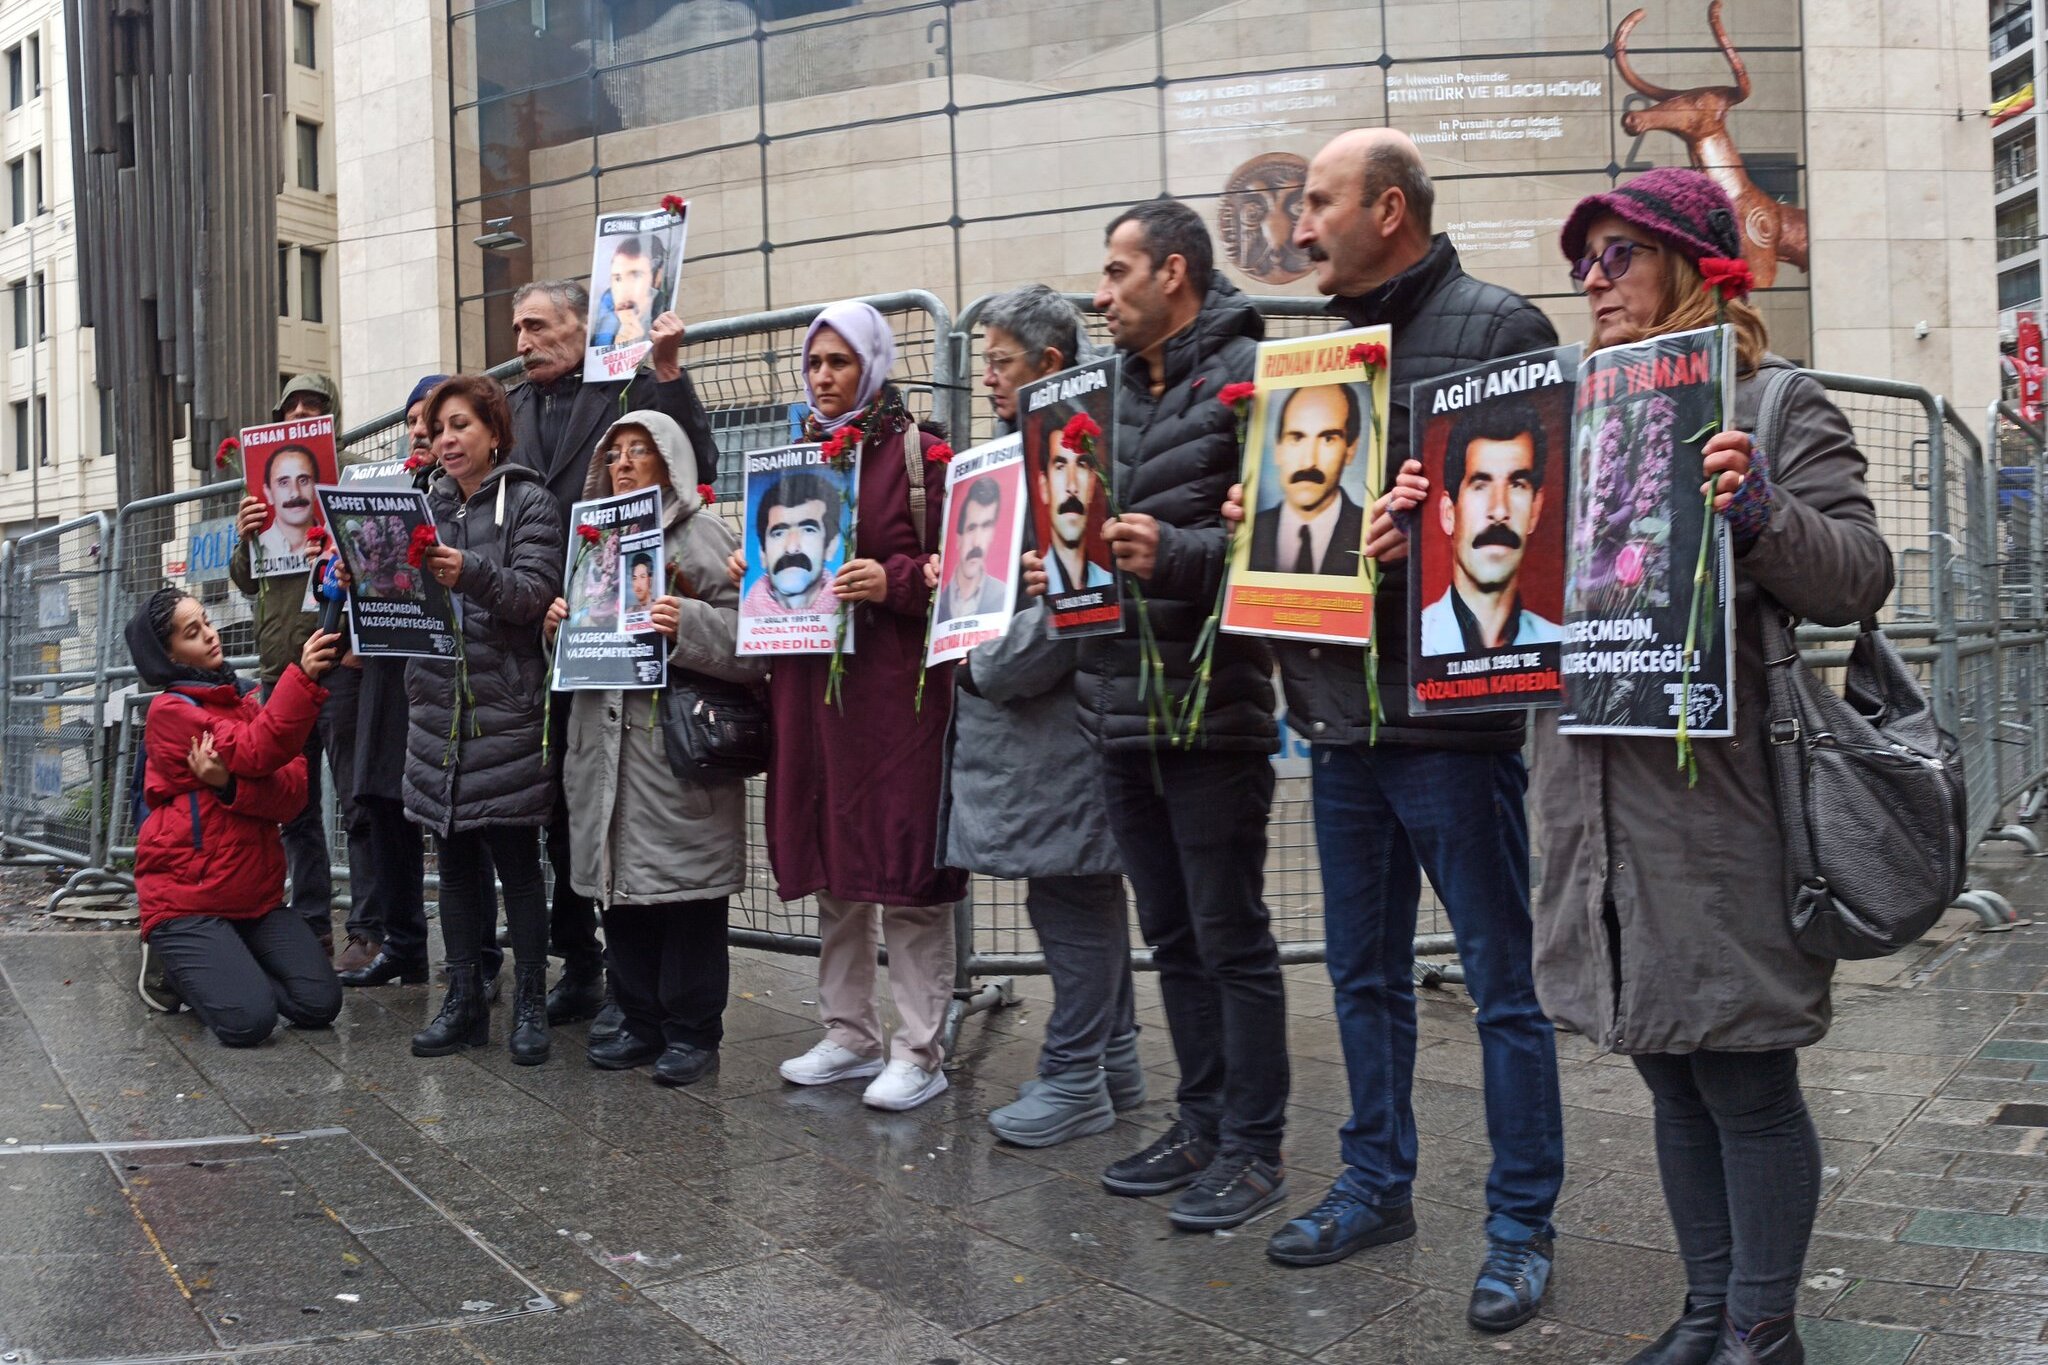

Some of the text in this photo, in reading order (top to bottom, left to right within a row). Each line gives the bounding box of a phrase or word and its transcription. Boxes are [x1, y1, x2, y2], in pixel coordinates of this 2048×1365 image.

[1467, 85, 1490, 99] VE
[1494, 83, 1545, 98] ALACA
[1439, 120, 1449, 130] In
[1624, 350, 1710, 395] YAMAN
[1028, 369, 1108, 412] AGİT AKİPA
[1432, 360, 1564, 414] AGİT AKİPA
[243, 420, 332, 447] KENAN BİLGİN
[350, 465, 375, 480] AGİT
[747, 450, 802, 473] İBRAHİM
[327, 495, 417, 511] SAFFET YAMAN
[580, 499, 654, 526] SAFFET YAMAN
[358, 601, 425, 616] VAZGEÇMEDİN,
[360, 616, 445, 631] VAZGEÇMEYECEĞİZ!
[1490, 667, 1561, 693] KAYBEDİL
